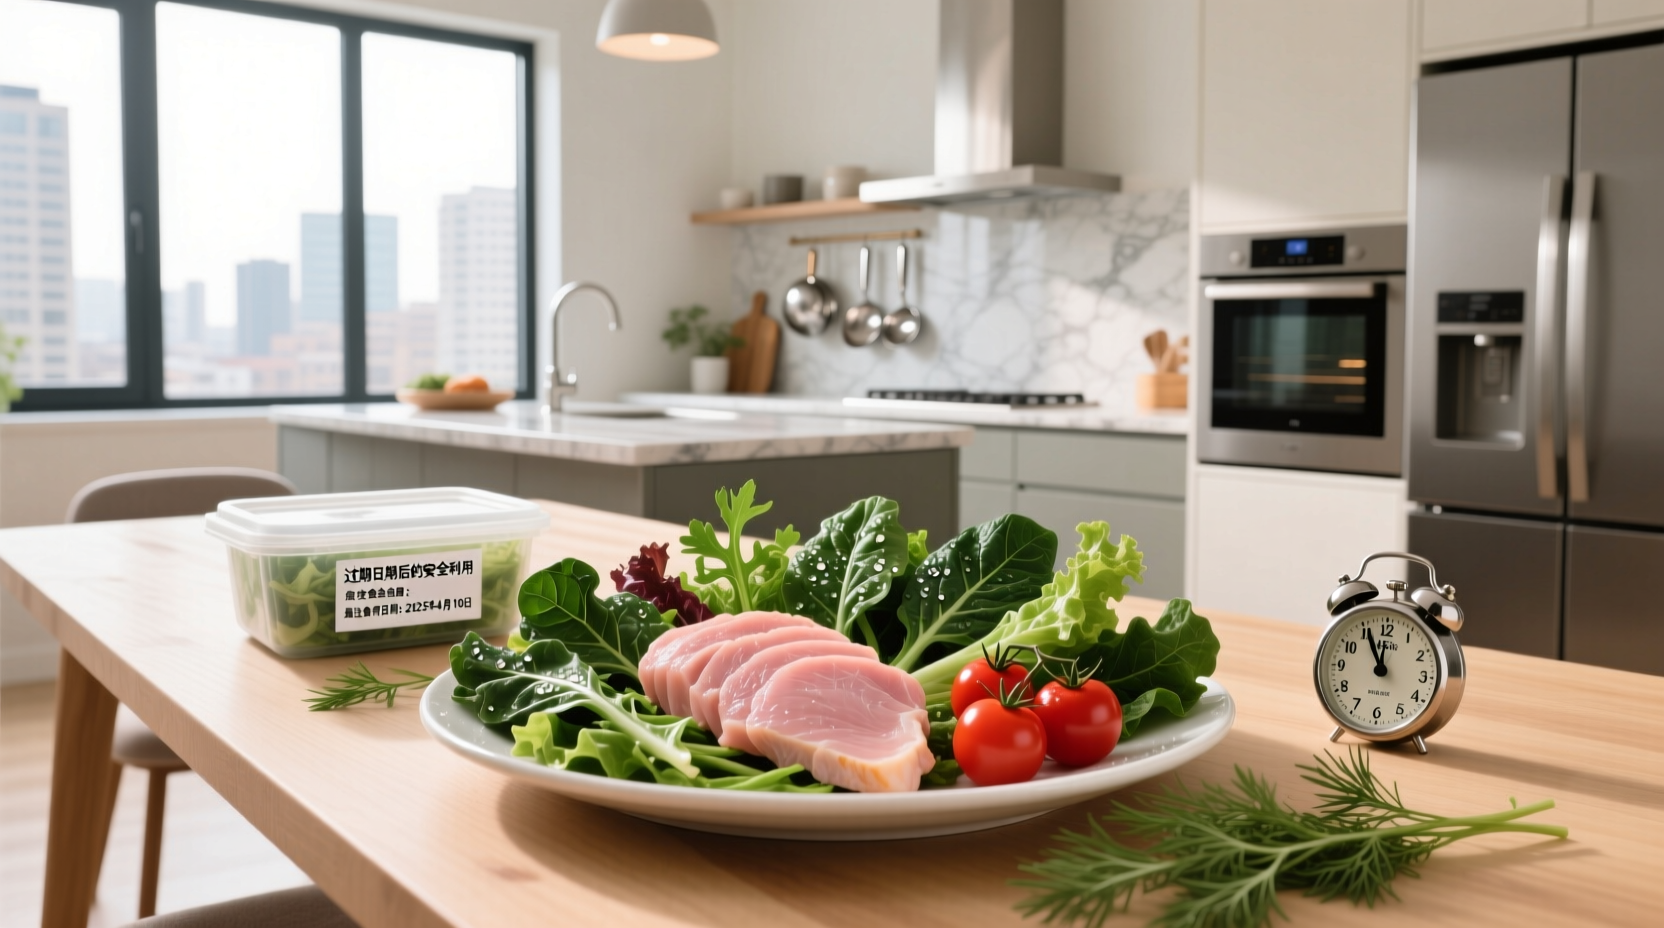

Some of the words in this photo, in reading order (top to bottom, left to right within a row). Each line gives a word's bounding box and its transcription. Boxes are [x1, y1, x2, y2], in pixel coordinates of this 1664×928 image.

[1381, 624, 1394, 637] 12
[1406, 632, 1410, 643] 1
[1345, 641, 1357, 654] 10
[1416, 650, 1425, 662] 2
[1337, 659, 1345, 671] 9
[1418, 670, 1428, 683] 3
[1340, 680, 1348, 692] 8
[1411, 689, 1419, 702] 4
[1353, 698, 1361, 710] 7
[1396, 703, 1404, 715] 5
[1373, 707, 1381, 719] 6
